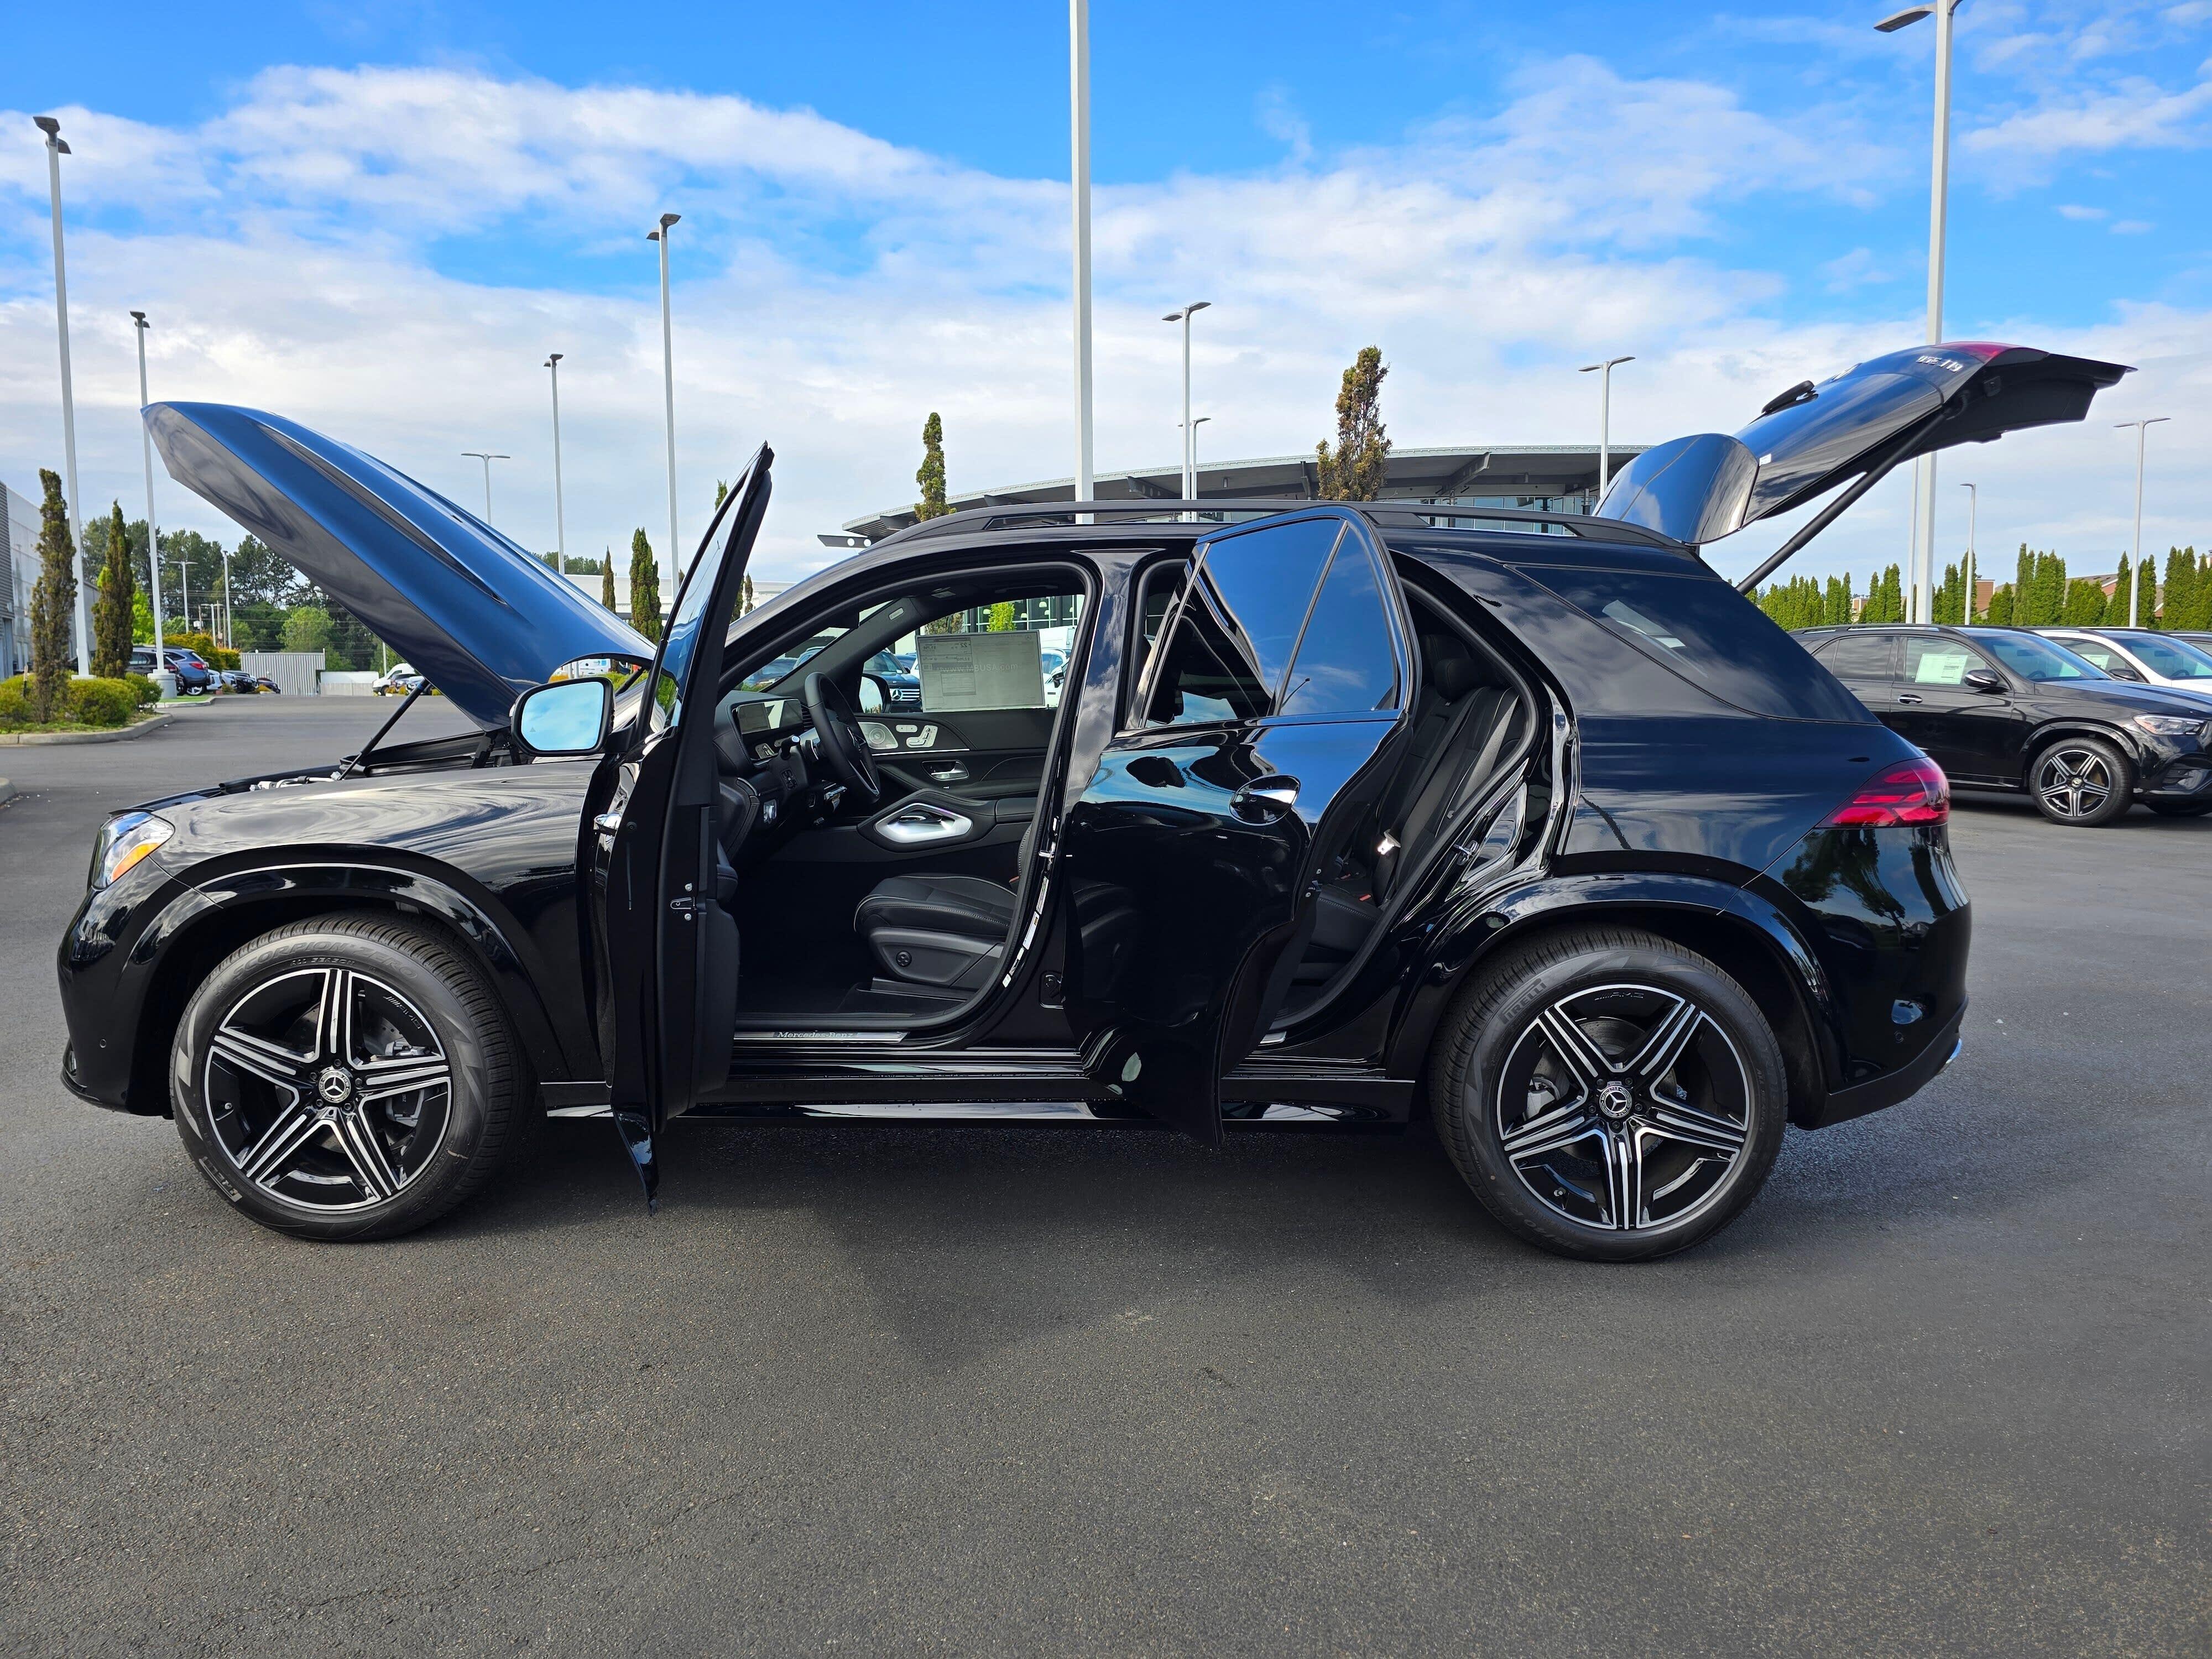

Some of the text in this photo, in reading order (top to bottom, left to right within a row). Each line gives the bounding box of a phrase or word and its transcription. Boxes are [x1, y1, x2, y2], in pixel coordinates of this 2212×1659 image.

[233, 941, 419, 980] SCORPION ZERO
[310, 957, 356, 966] SEASON
[1498, 978, 1547, 1024] PIRELLI
